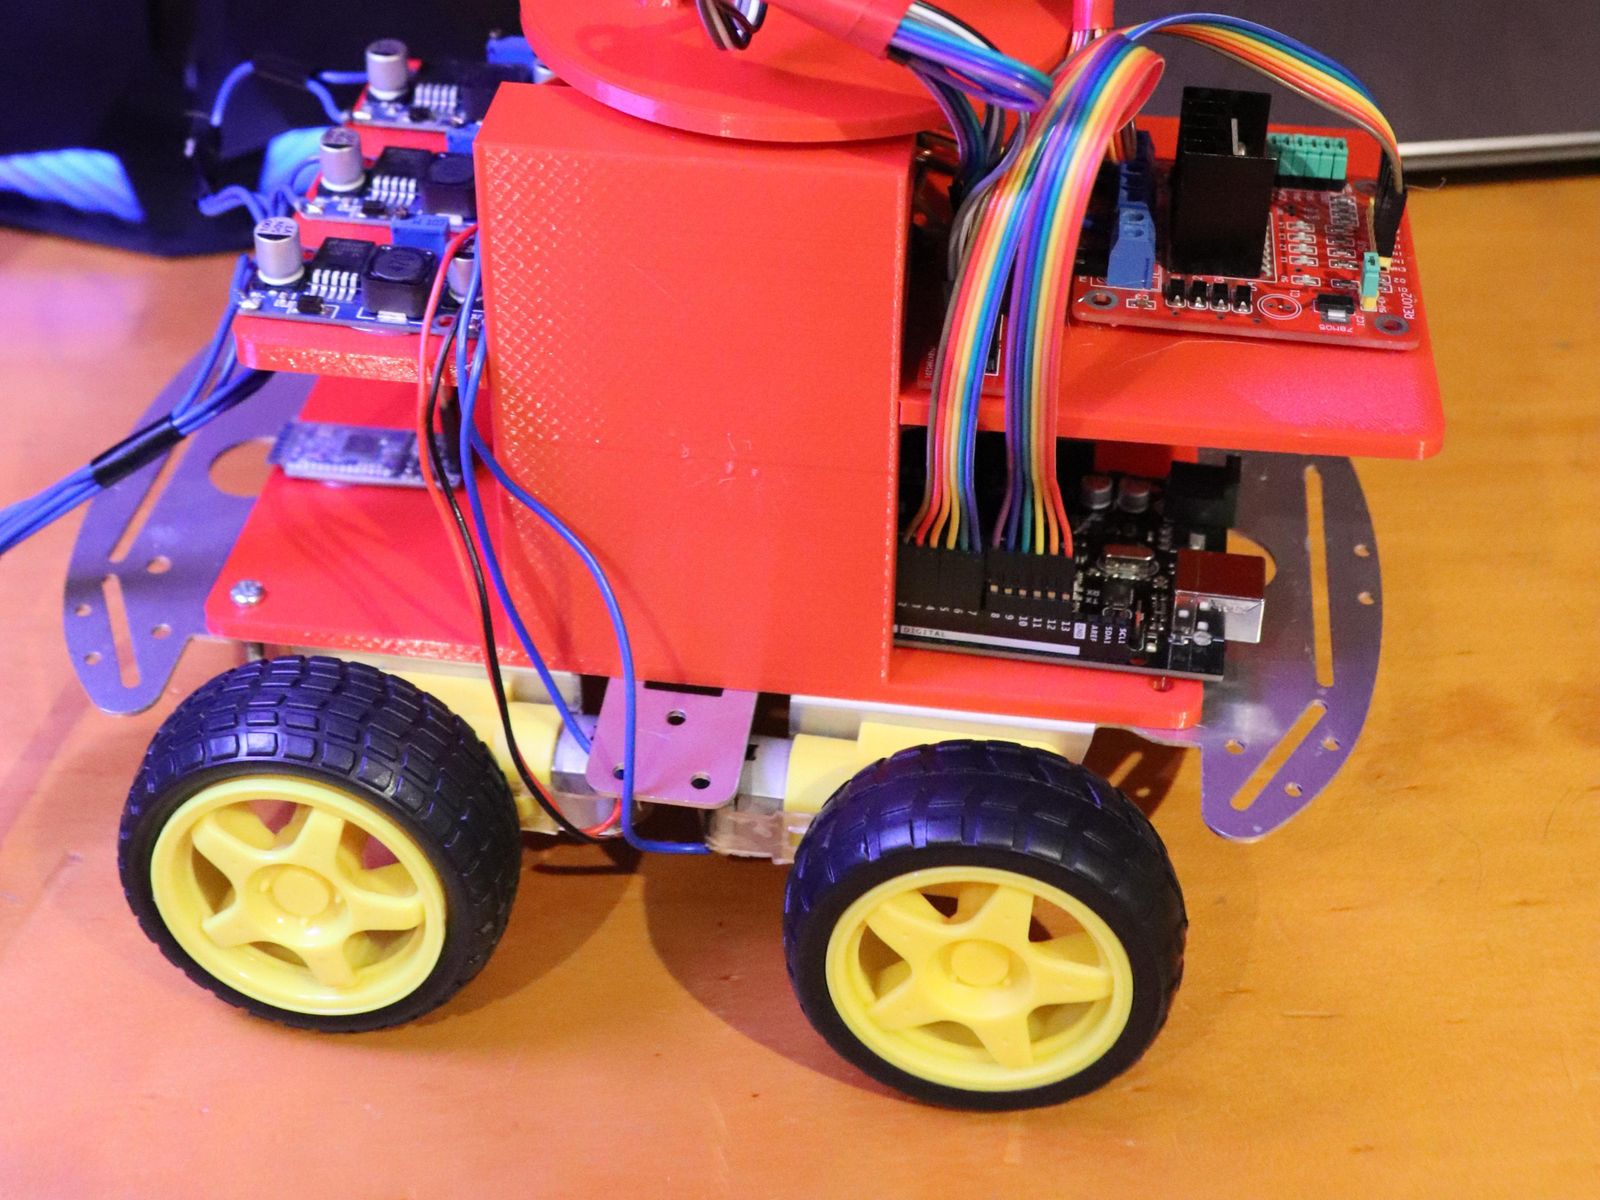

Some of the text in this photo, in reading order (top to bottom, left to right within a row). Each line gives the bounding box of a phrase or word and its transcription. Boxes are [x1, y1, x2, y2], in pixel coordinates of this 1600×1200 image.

[1018, 616, 1028, 627] 10
[1033, 617, 1042, 628] 11
[1047, 619, 1056, 631] 12
[1061, 621, 1070, 632] 13
